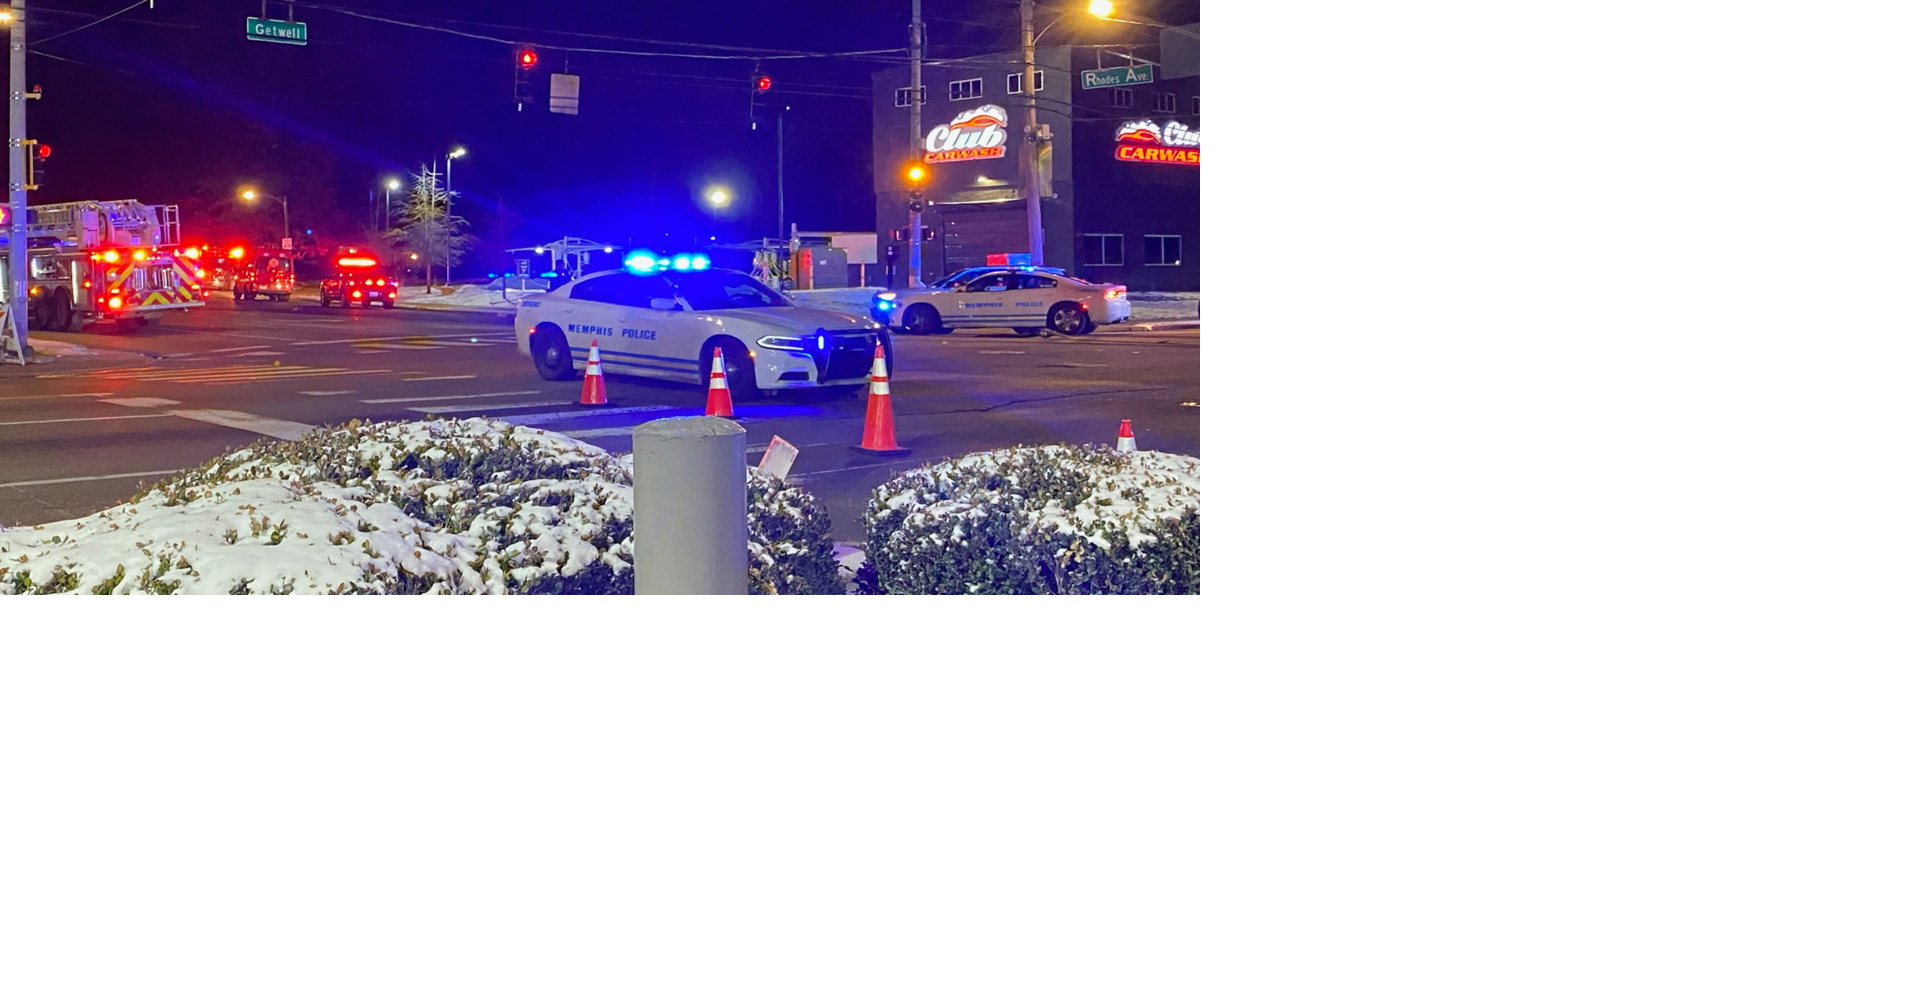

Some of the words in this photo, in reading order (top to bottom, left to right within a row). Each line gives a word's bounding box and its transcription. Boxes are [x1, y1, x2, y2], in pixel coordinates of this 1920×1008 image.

[255, 23, 300, 39] Getwell
[1085, 72, 1120, 86] Rhodes
[926, 123, 1003, 152] Club
[1164, 121, 1200, 146] Clu
[925, 147, 1000, 161] CARWASH
[1120, 146, 1200, 163] CARWAS
[568, 323, 613, 336] MEMPHIS
[622, 328, 657, 340] POLICE
